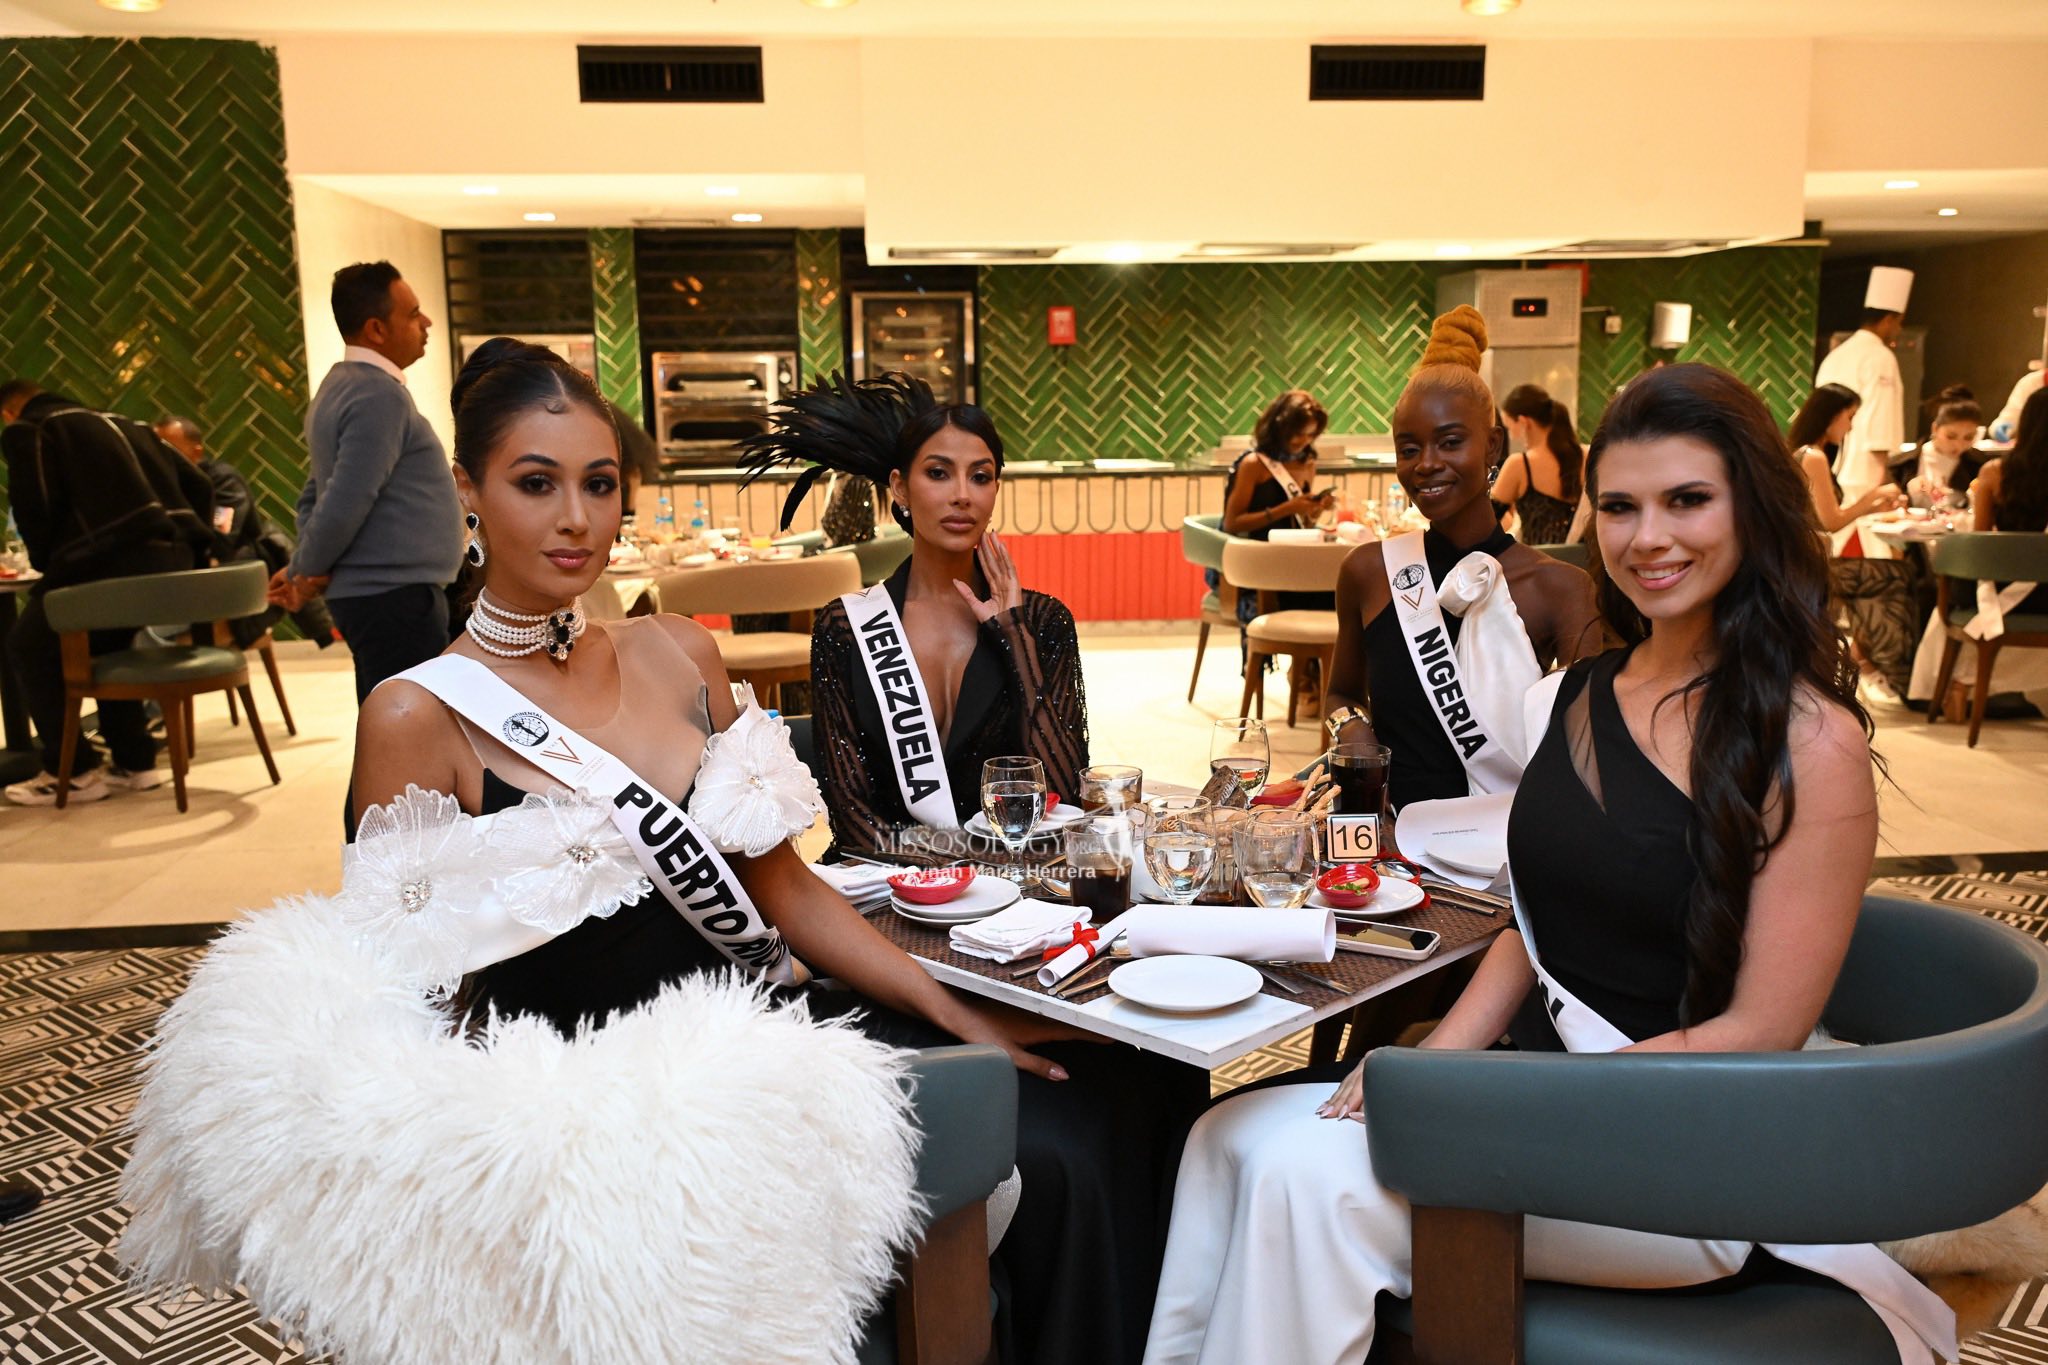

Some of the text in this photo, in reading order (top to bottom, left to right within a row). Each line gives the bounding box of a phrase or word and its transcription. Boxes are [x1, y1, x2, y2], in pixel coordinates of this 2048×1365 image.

[859, 609, 942, 806] VENEZUELA
[1413, 625, 1489, 761] NIGERIA
[613, 781, 749, 936] PUERTO
[1335, 824, 1374, 852] 16
